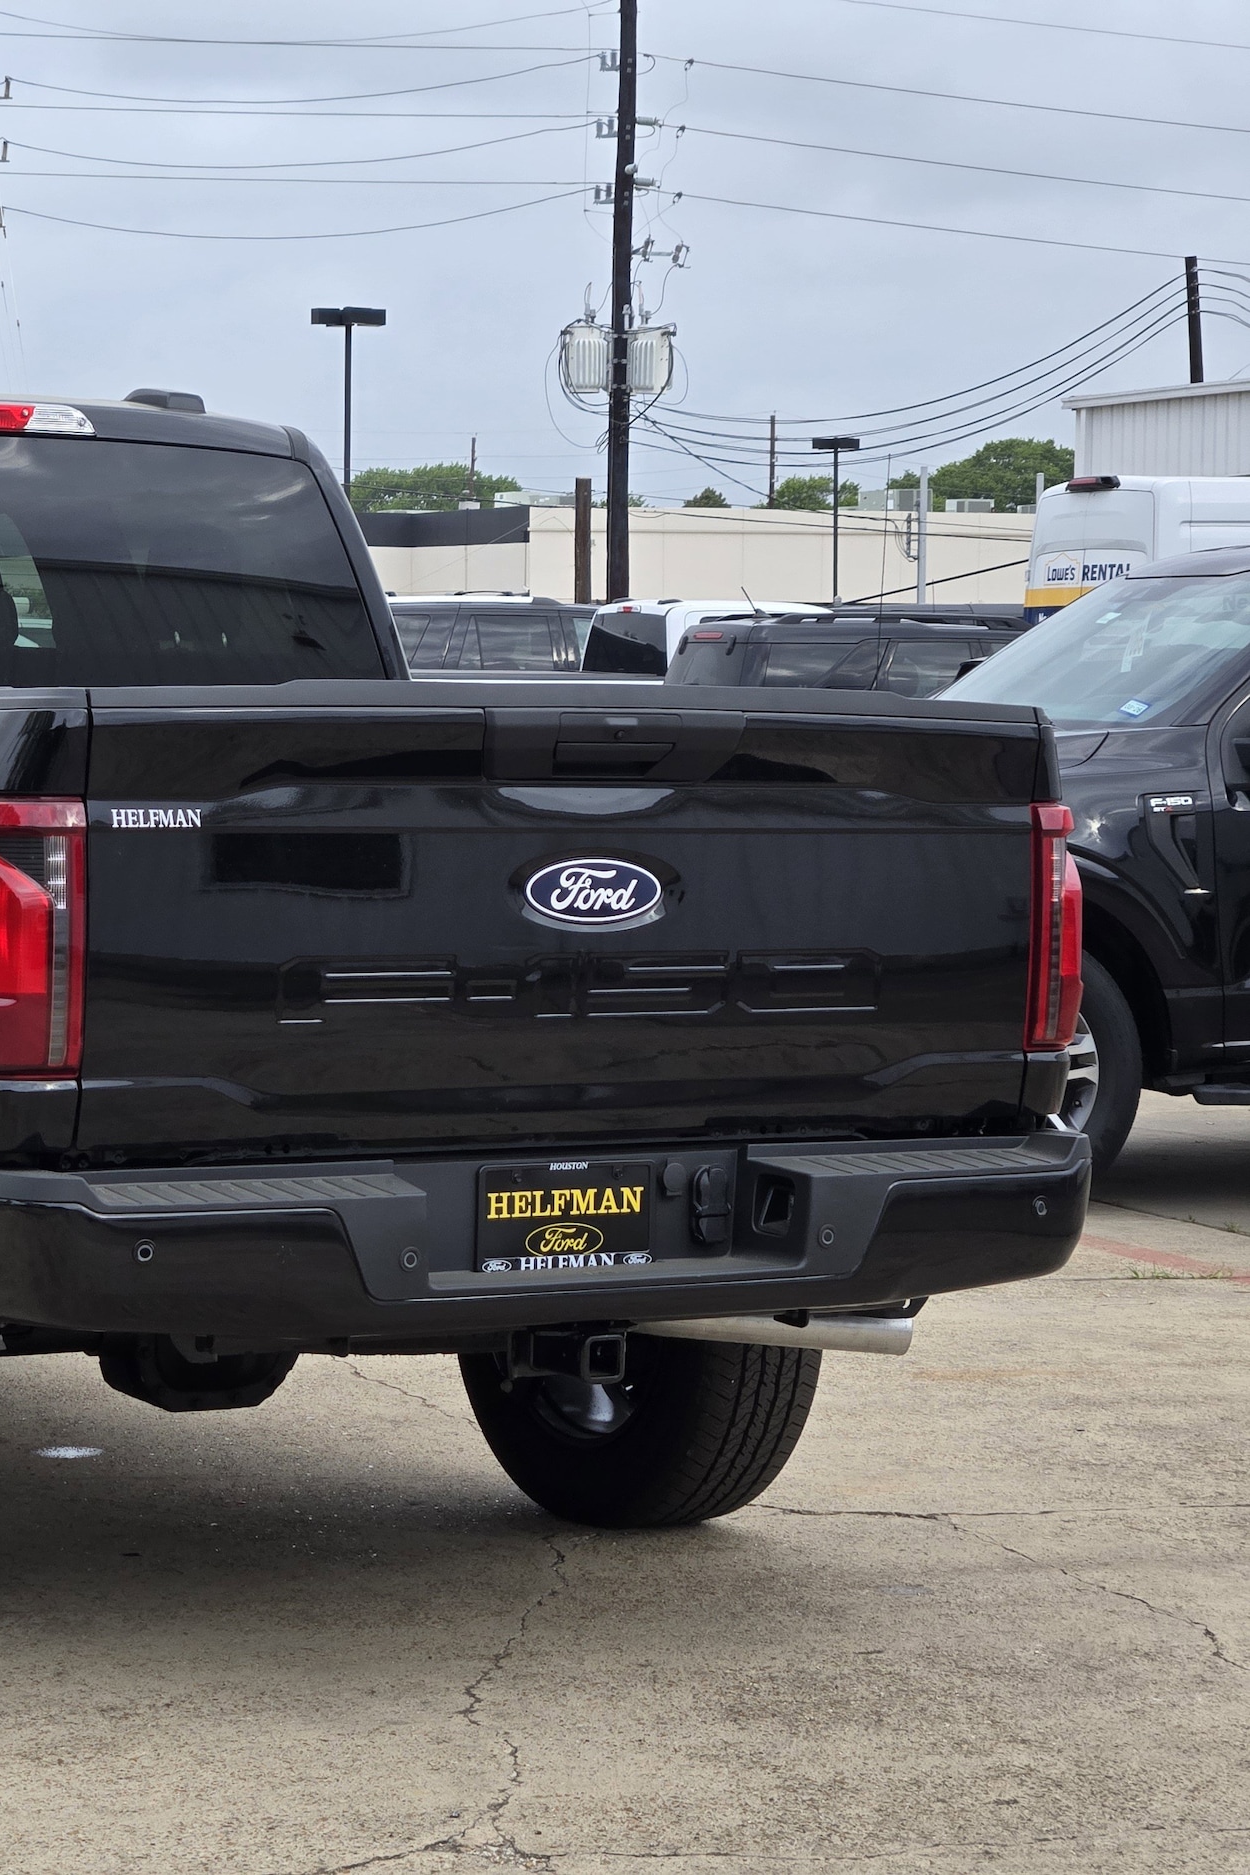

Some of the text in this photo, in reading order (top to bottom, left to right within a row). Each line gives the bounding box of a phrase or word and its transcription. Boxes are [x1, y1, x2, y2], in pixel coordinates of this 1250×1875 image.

[111, 809, 201, 828] HELFMAN
[550, 867, 639, 910] Ford
[550, 1161, 589, 1171] HOUSTON
[487, 1186, 644, 1219] HELFMAN
[540, 1227, 588, 1252] Ford
